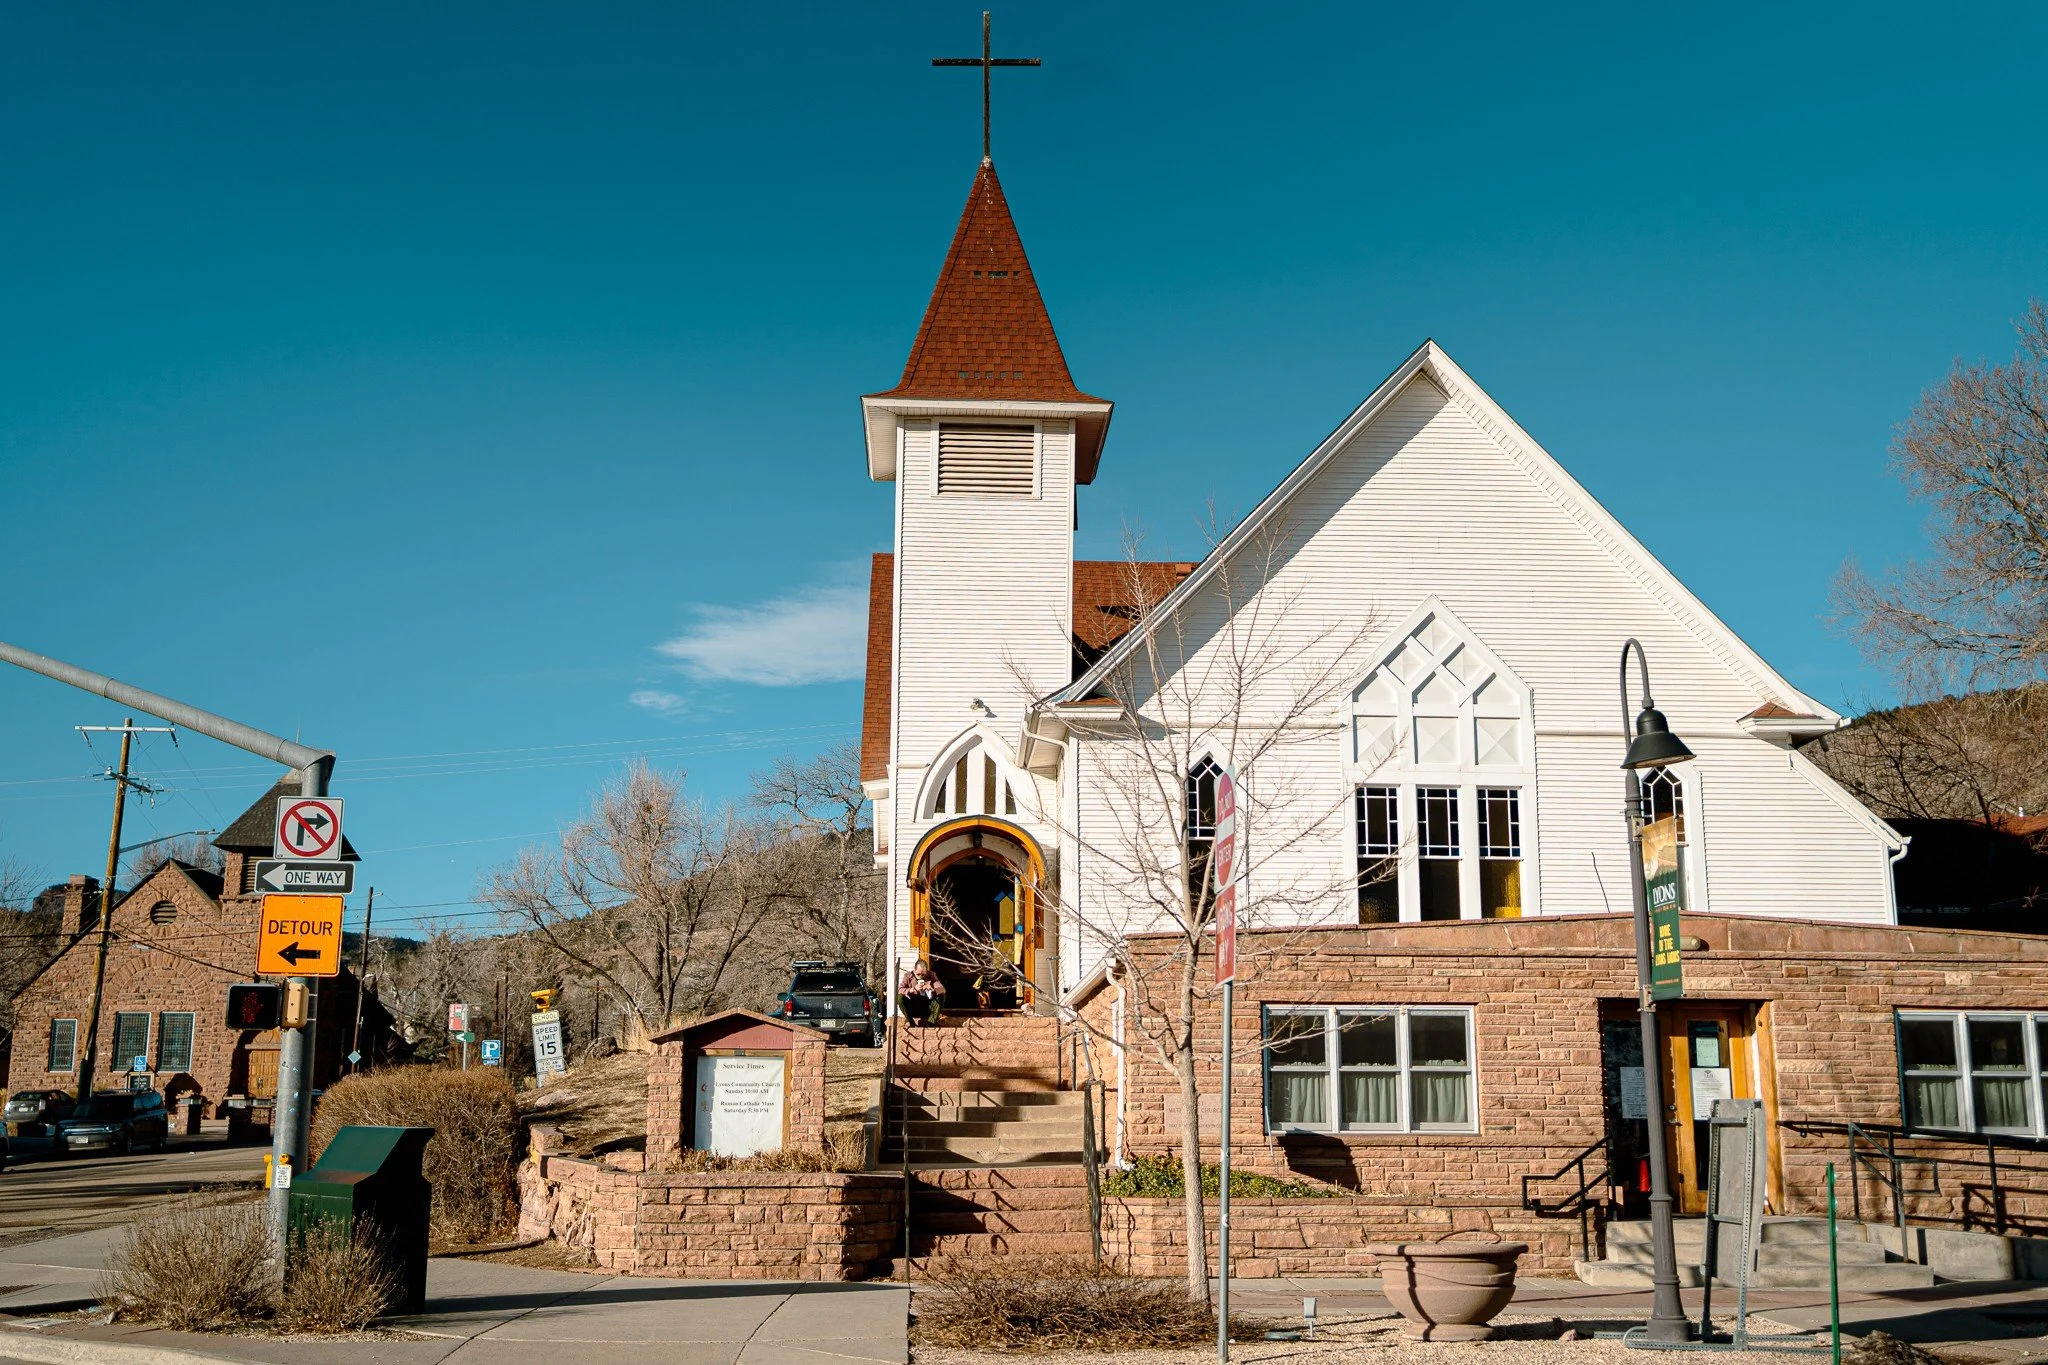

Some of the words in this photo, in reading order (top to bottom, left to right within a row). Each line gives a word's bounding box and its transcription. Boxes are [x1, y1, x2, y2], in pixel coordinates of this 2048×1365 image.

[1219, 843, 1232, 866] ENTER
[285, 871, 312, 884] ONE
[316, 871, 343, 884] WAY
[1653, 882, 1676, 905] LYONS
[268, 919, 332, 936] DETOUR
[534, 1013, 557, 1022] SCHOOL
[535, 1026, 558, 1035] SPEED
[538, 1034, 556, 1042] LIMIT
[484, 1041, 499, 1058] P
[540, 1041, 556, 1056] 15
